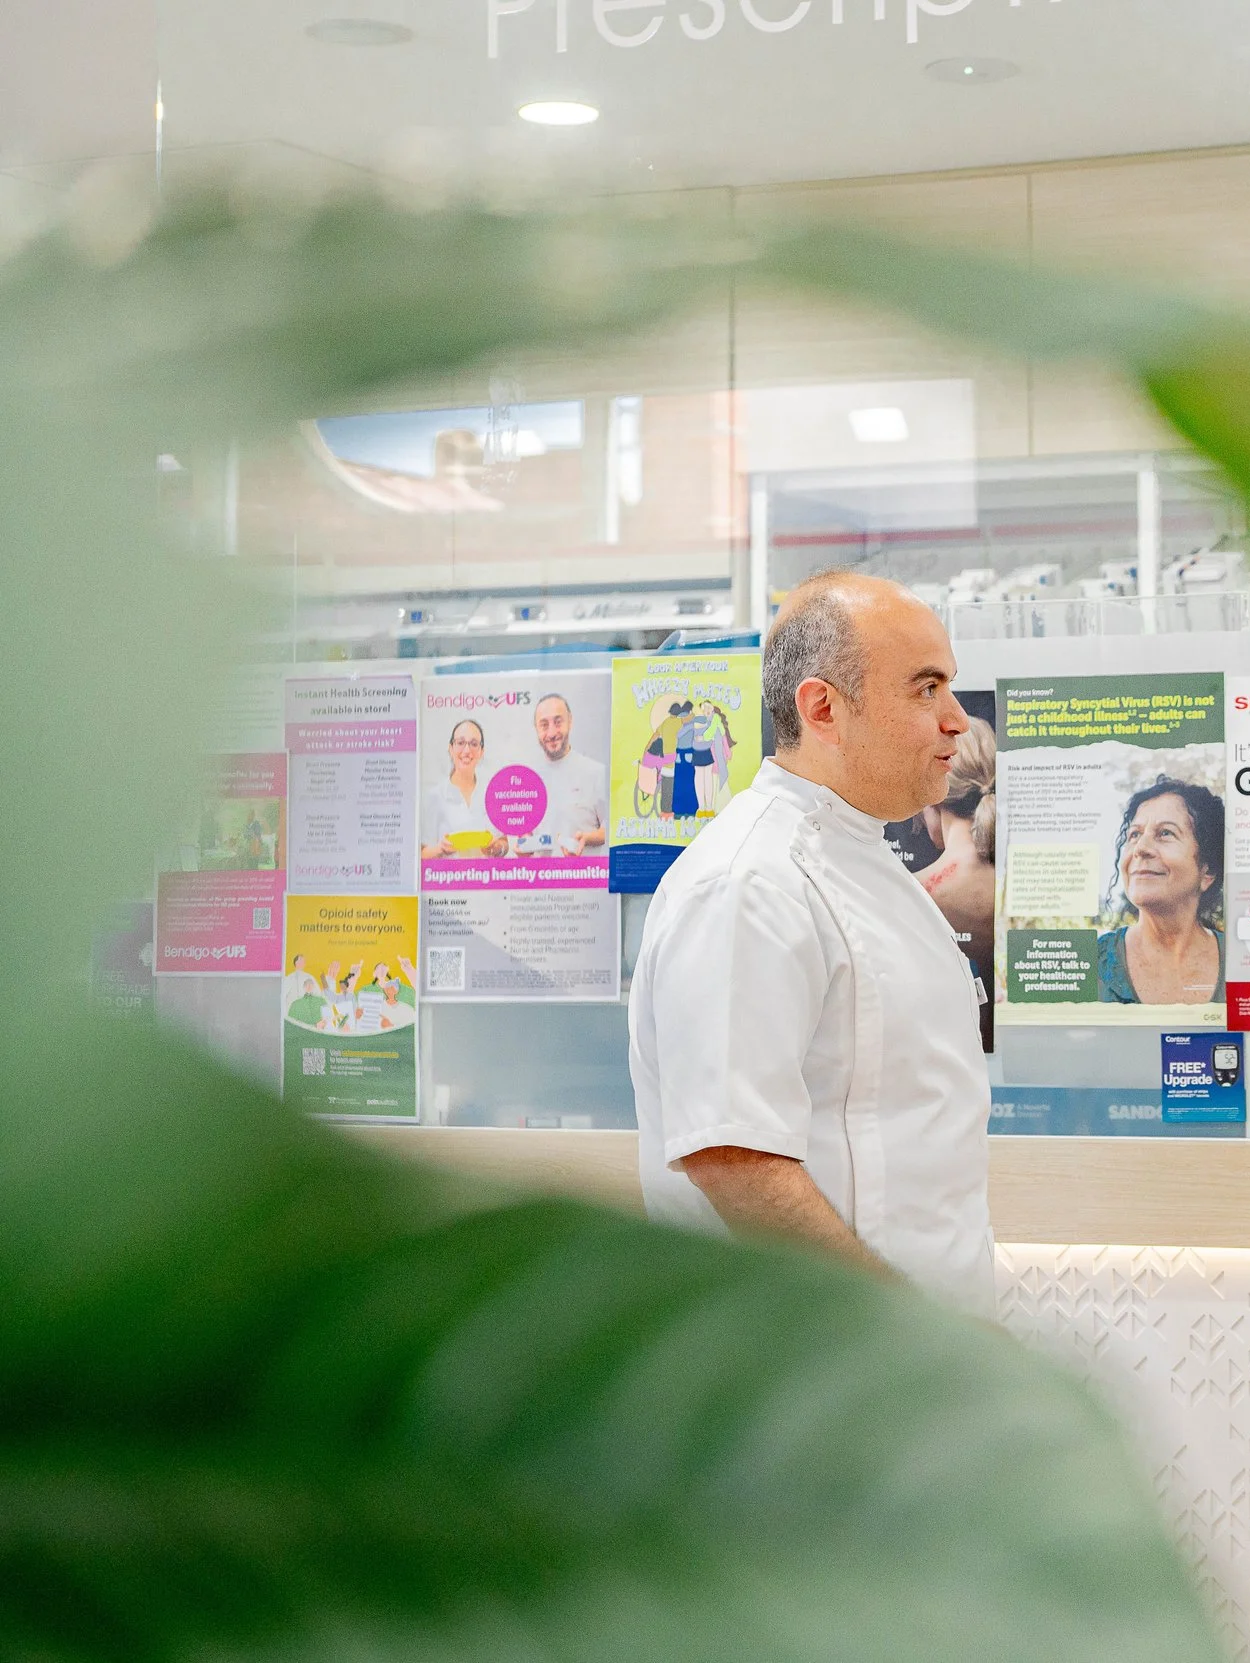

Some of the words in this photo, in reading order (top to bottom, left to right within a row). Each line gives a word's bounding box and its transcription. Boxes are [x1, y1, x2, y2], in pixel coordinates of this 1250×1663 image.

[647, 661, 672, 673] LOOK
[295, 690, 328, 699] Instant
[330, 688, 360, 698] Health
[362, 687, 407, 698] Screening
[1007, 689, 1018, 697] Did
[427, 693, 484, 710] Bendigo
[506, 692, 531, 705] UFS
[1007, 700, 1068, 712] Respiratory
[1070, 697, 1120, 711] Syncytial
[1121, 697, 1150, 708] Virus
[1152, 695, 1182, 708] (RSV)
[1183, 695, 1193, 706] is
[1195, 695, 1215, 706] not
[311, 705, 352, 715] available
[355, 704, 362, 713] in
[365, 704, 391, 713] store!
[1007, 713, 1027, 725] just
[1029, 715, 1036, 723] a
[1037, 711, 1092, 723] childhood
[1149, 710, 1183, 720] adults
[1185, 710, 1206, 719] can
[335, 727, 358, 736] about
[361, 729, 378, 737] your
[381, 727, 402, 735] heart
[1007, 725, 1036, 737] catch
[1039, 726, 1047, 736] it
[1049, 723, 1112, 737] throughout
[1114, 723, 1140, 734] their
[510, 776, 522, 785] Flu
[495, 790, 538, 799] vaccinations
[502, 803, 532, 812] available
[1235, 807, 1248, 816] Do
[508, 816, 525, 825] now!
[1235, 820, 1250, 829] and
[616, 817, 676, 839] ASTHMA
[425, 867, 490, 884] Supporting
[492, 867, 536, 883] healthy
[319, 908, 353, 919] Opioid
[356, 908, 388, 920] safety
[300, 924, 339, 933] matters
[343, 924, 352, 932] to
[355, 925, 405, 935] everyone.
[1033, 939, 1047, 948] For
[164, 945, 209, 960] Bendigo
[227, 945, 246, 957] UFS
[1027, 950, 1078, 959] information
[1014, 961, 1040, 969] about
[1041, 961, 1060, 970] RSV,
[1062, 961, 1079, 969] talk
[1080, 961, 1090, 969] to
[1019, 973, 1039, 982] your
[1040, 972, 1086, 980] healthcare
[1025, 982, 1080, 992] professional.
[1164, 1074, 1213, 1087] Upgrade
